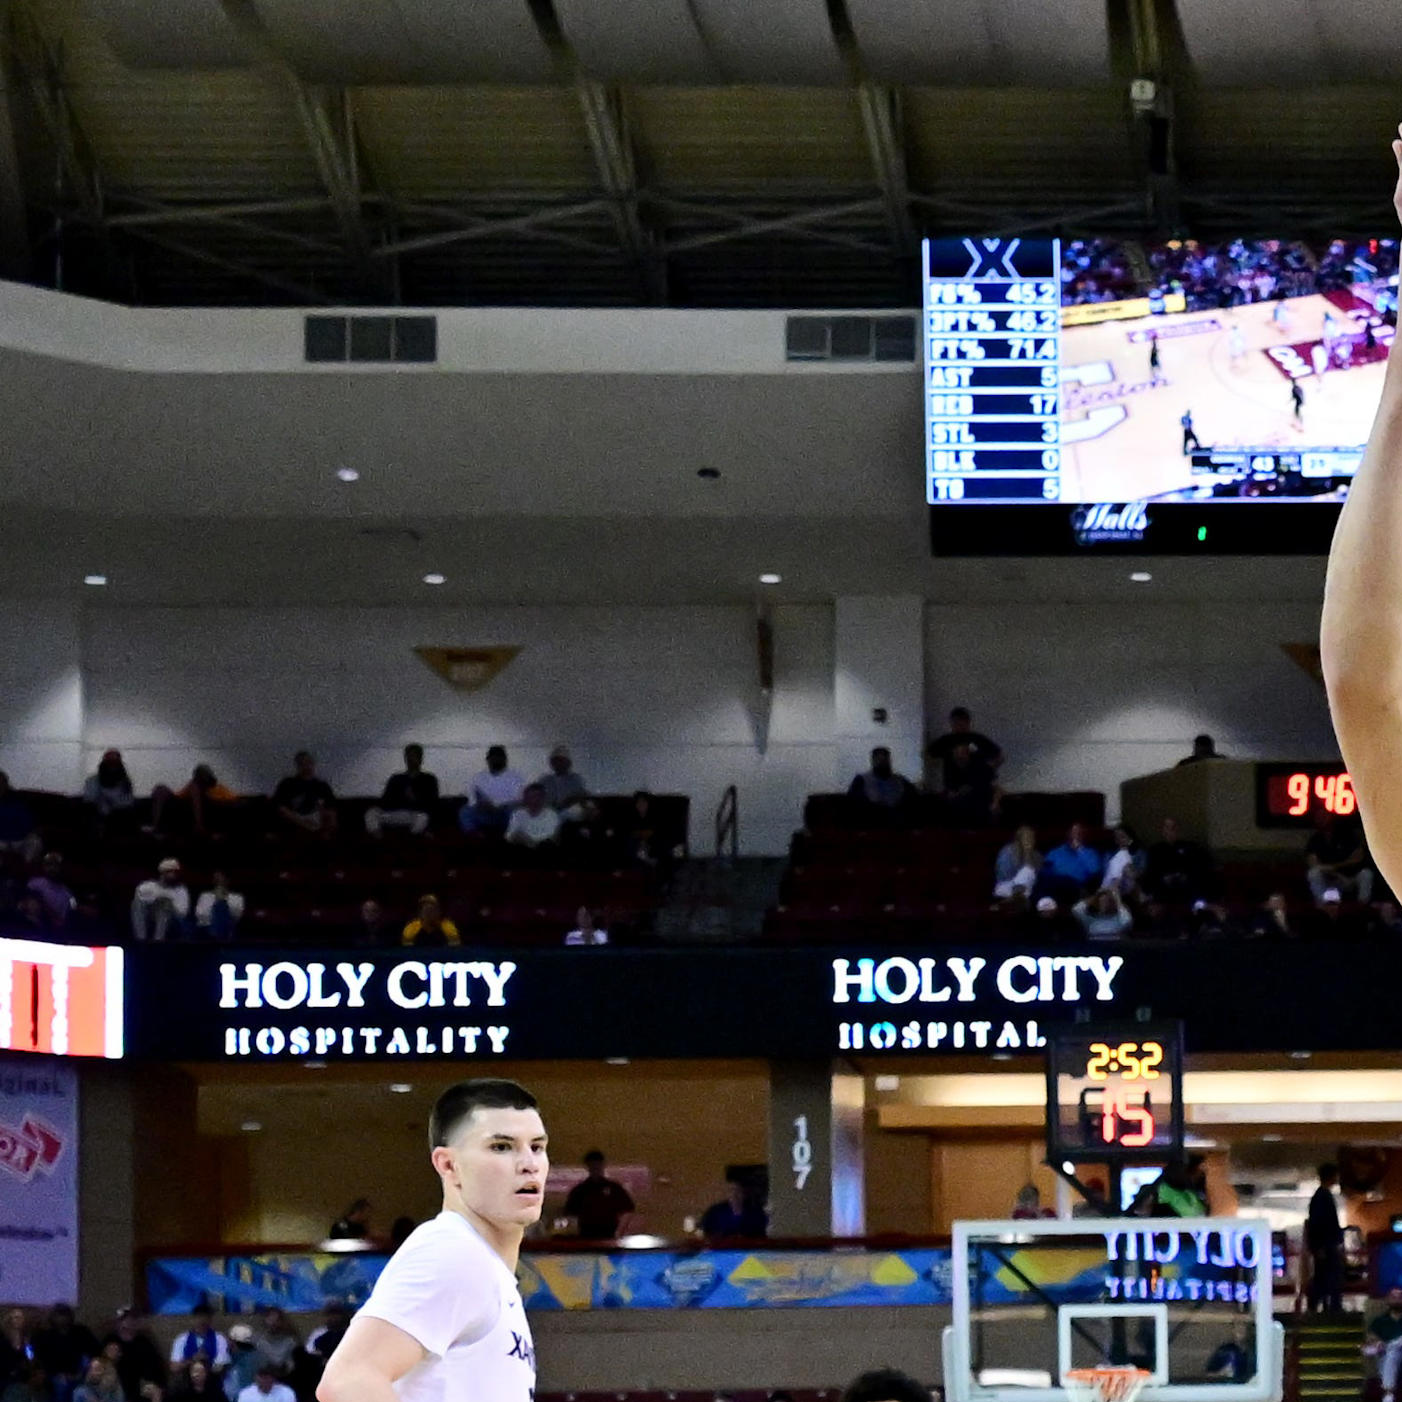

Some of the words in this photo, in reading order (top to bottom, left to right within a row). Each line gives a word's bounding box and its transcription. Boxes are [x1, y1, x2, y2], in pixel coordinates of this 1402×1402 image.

[1005, 284, 1056, 303] 45.2
[1006, 311, 1056, 331] 46.2
[1009, 339, 1056, 359] 71.4
[931, 368, 973, 387] AST
[1041, 368, 1057, 386] 5
[1030, 395, 1057, 414] 17
[932, 424, 975, 443] STL
[1042, 423, 1058, 442] 3
[933, 451, 976, 471] BLK
[1042, 451, 1059, 470] 0
[1043, 479, 1059, 499] 5
[219, 961, 375, 1010] HOLY
[387, 961, 517, 1010] CITY
[832, 956, 986, 1004] HOLY
[996, 955, 1124, 1004] CITY
[225, 1026, 511, 1055] HOSPITALITY
[1087, 1041, 1164, 1082] 2:52
[790, 1115, 812, 1190] 107
